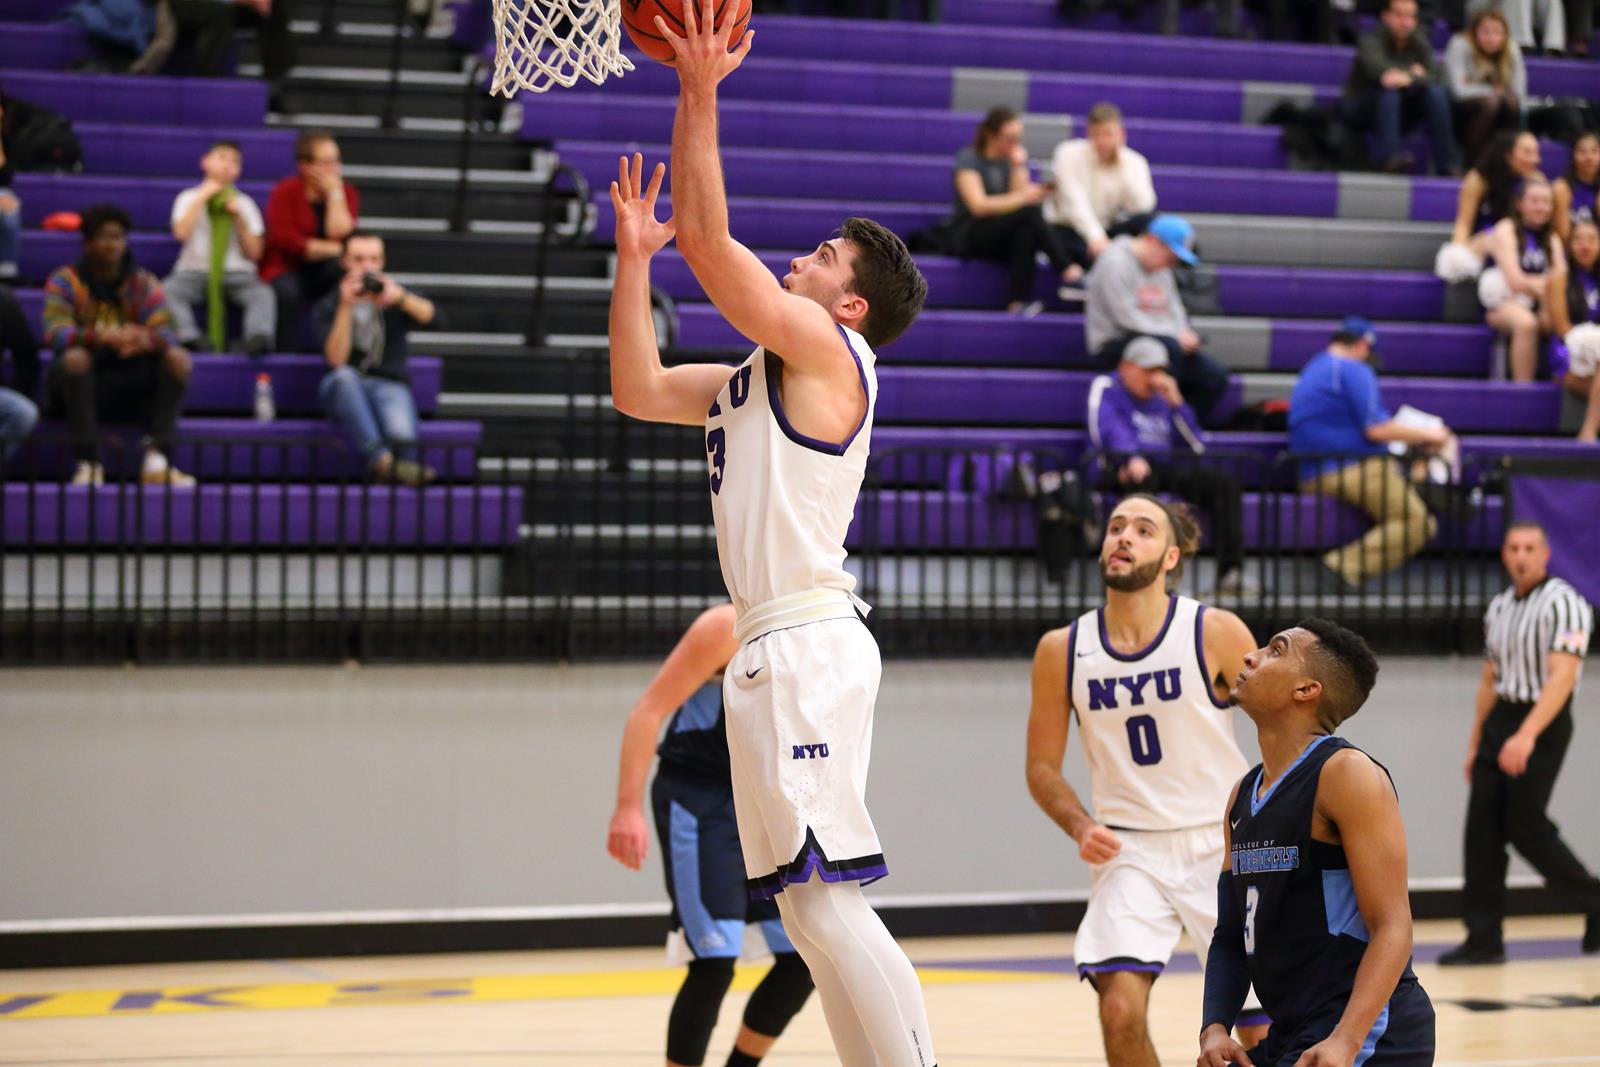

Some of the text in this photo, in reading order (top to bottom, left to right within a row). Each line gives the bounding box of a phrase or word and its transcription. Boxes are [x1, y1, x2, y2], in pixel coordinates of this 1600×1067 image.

[706, 425, 726, 496] 3
[1087, 667, 1182, 711] NYU
[792, 743, 829, 759] NYU
[1125, 714, 1162, 767] 0
[1263, 839, 1275, 847] OF
[1243, 885, 1260, 955] 3
